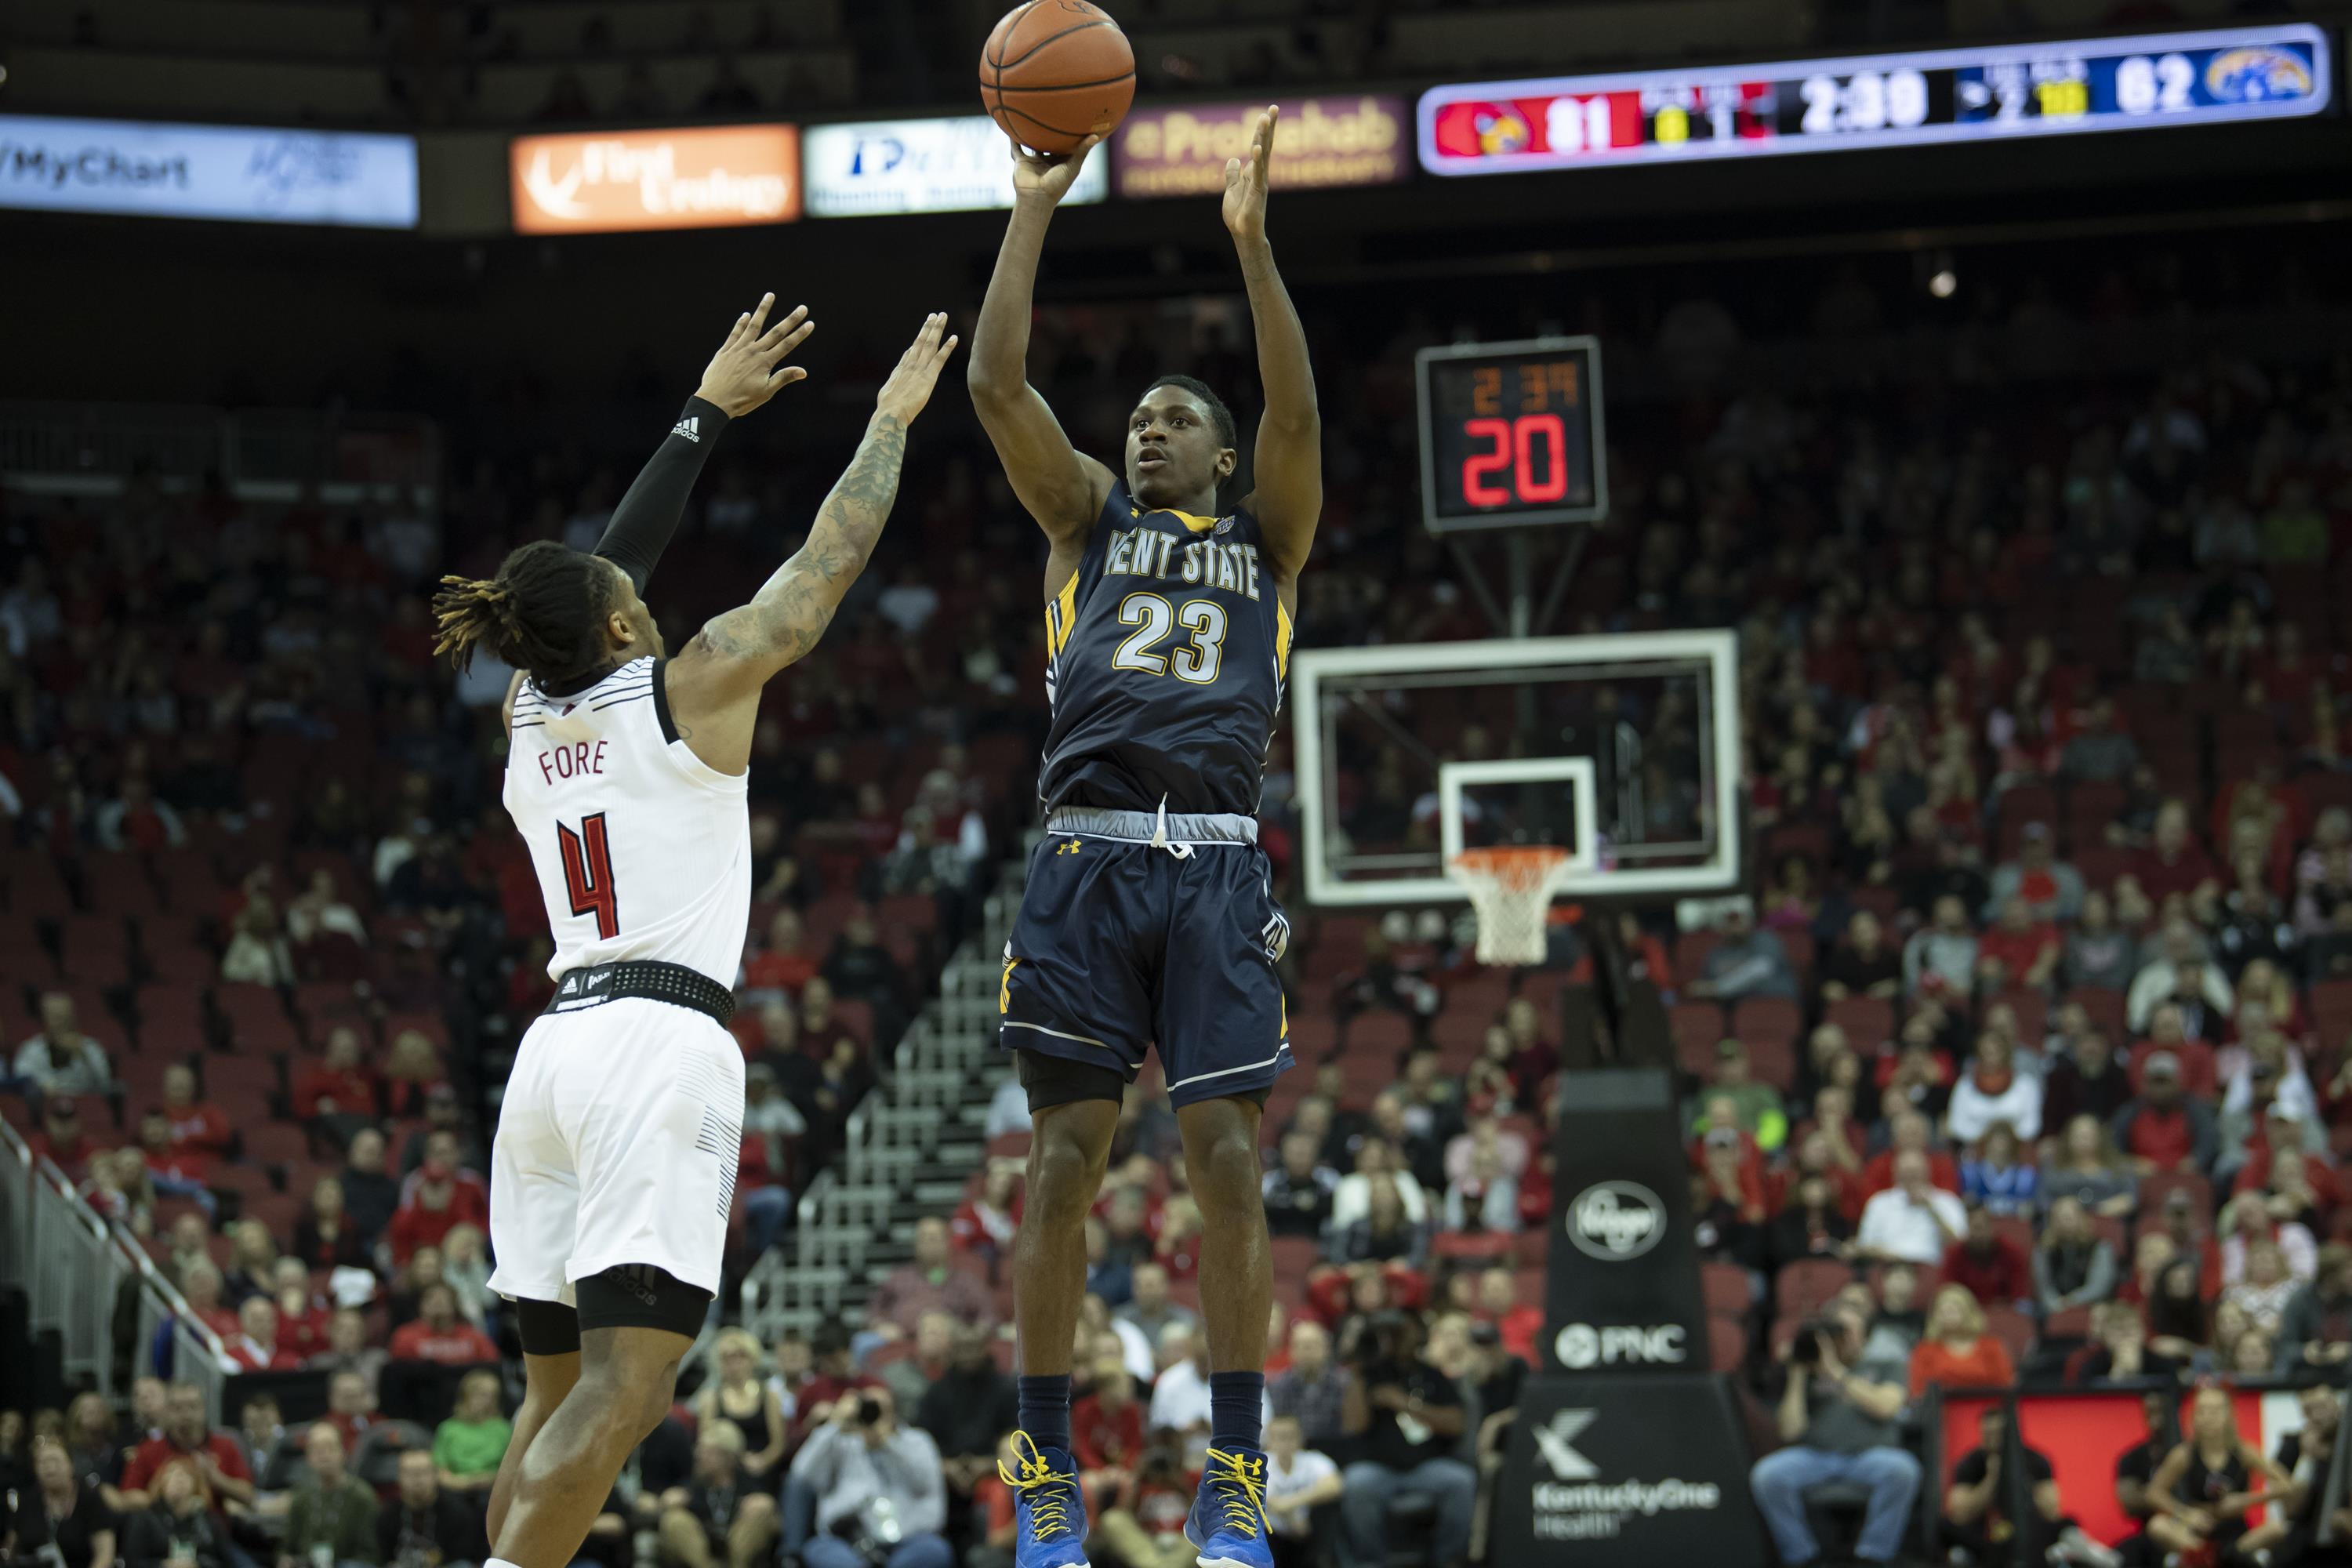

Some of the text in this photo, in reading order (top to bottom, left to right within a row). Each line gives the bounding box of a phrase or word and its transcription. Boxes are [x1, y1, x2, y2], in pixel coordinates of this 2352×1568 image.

[1462, 414, 1567, 506] 20
[1104, 526, 1260, 601] KENT STATE
[1112, 591, 1229, 684] 23
[539, 740, 608, 786] FORE
[556, 811, 619, 941] 4
[1601, 1324, 1686, 1364] PNC
[1532, 1478, 1721, 1516] KentuckyOne
